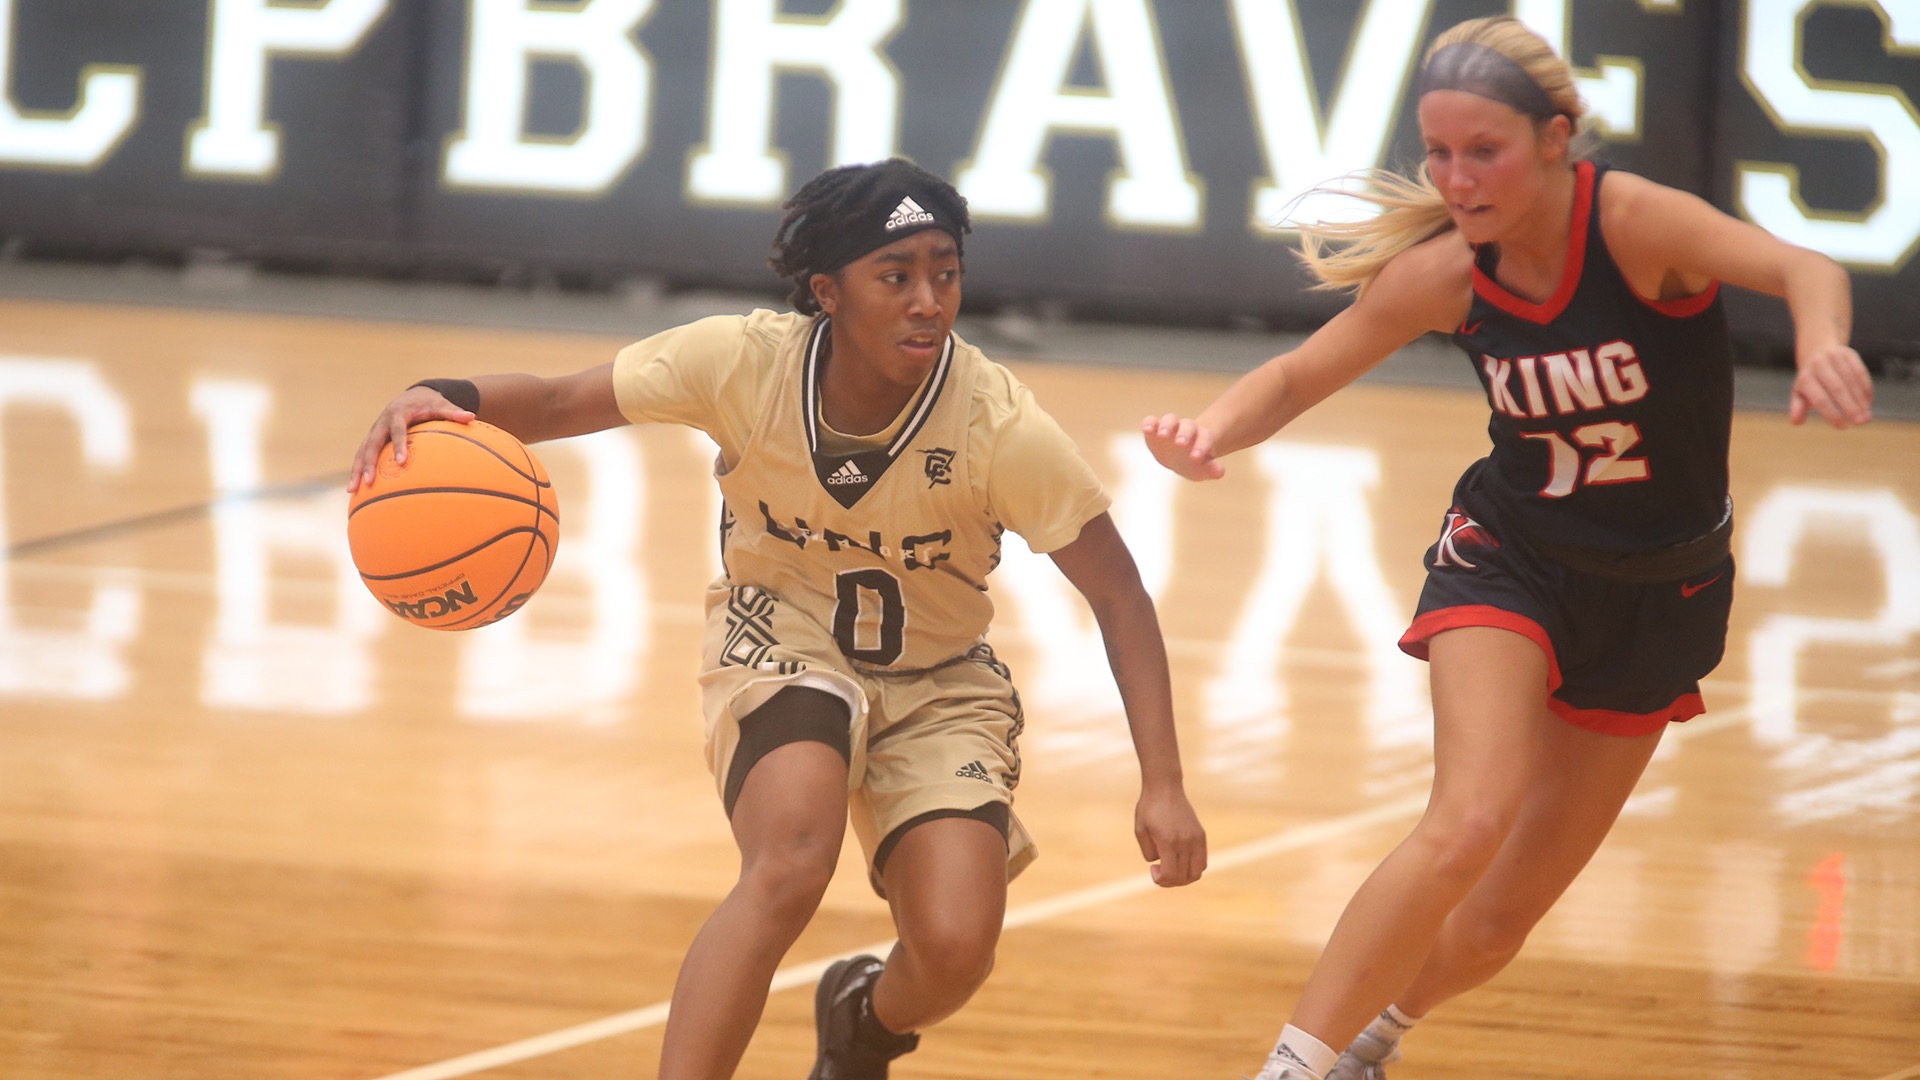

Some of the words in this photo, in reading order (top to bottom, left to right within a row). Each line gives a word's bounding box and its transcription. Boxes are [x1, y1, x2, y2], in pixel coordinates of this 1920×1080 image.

[885, 212, 934, 229] adidas
[1481, 338, 1650, 419] KING
[1519, 419, 1651, 499] 12
[827, 475, 869, 485] adidas
[383, 580, 479, 619] NCAA
[832, 566, 908, 666] 0
[955, 770, 993, 784] adidas
